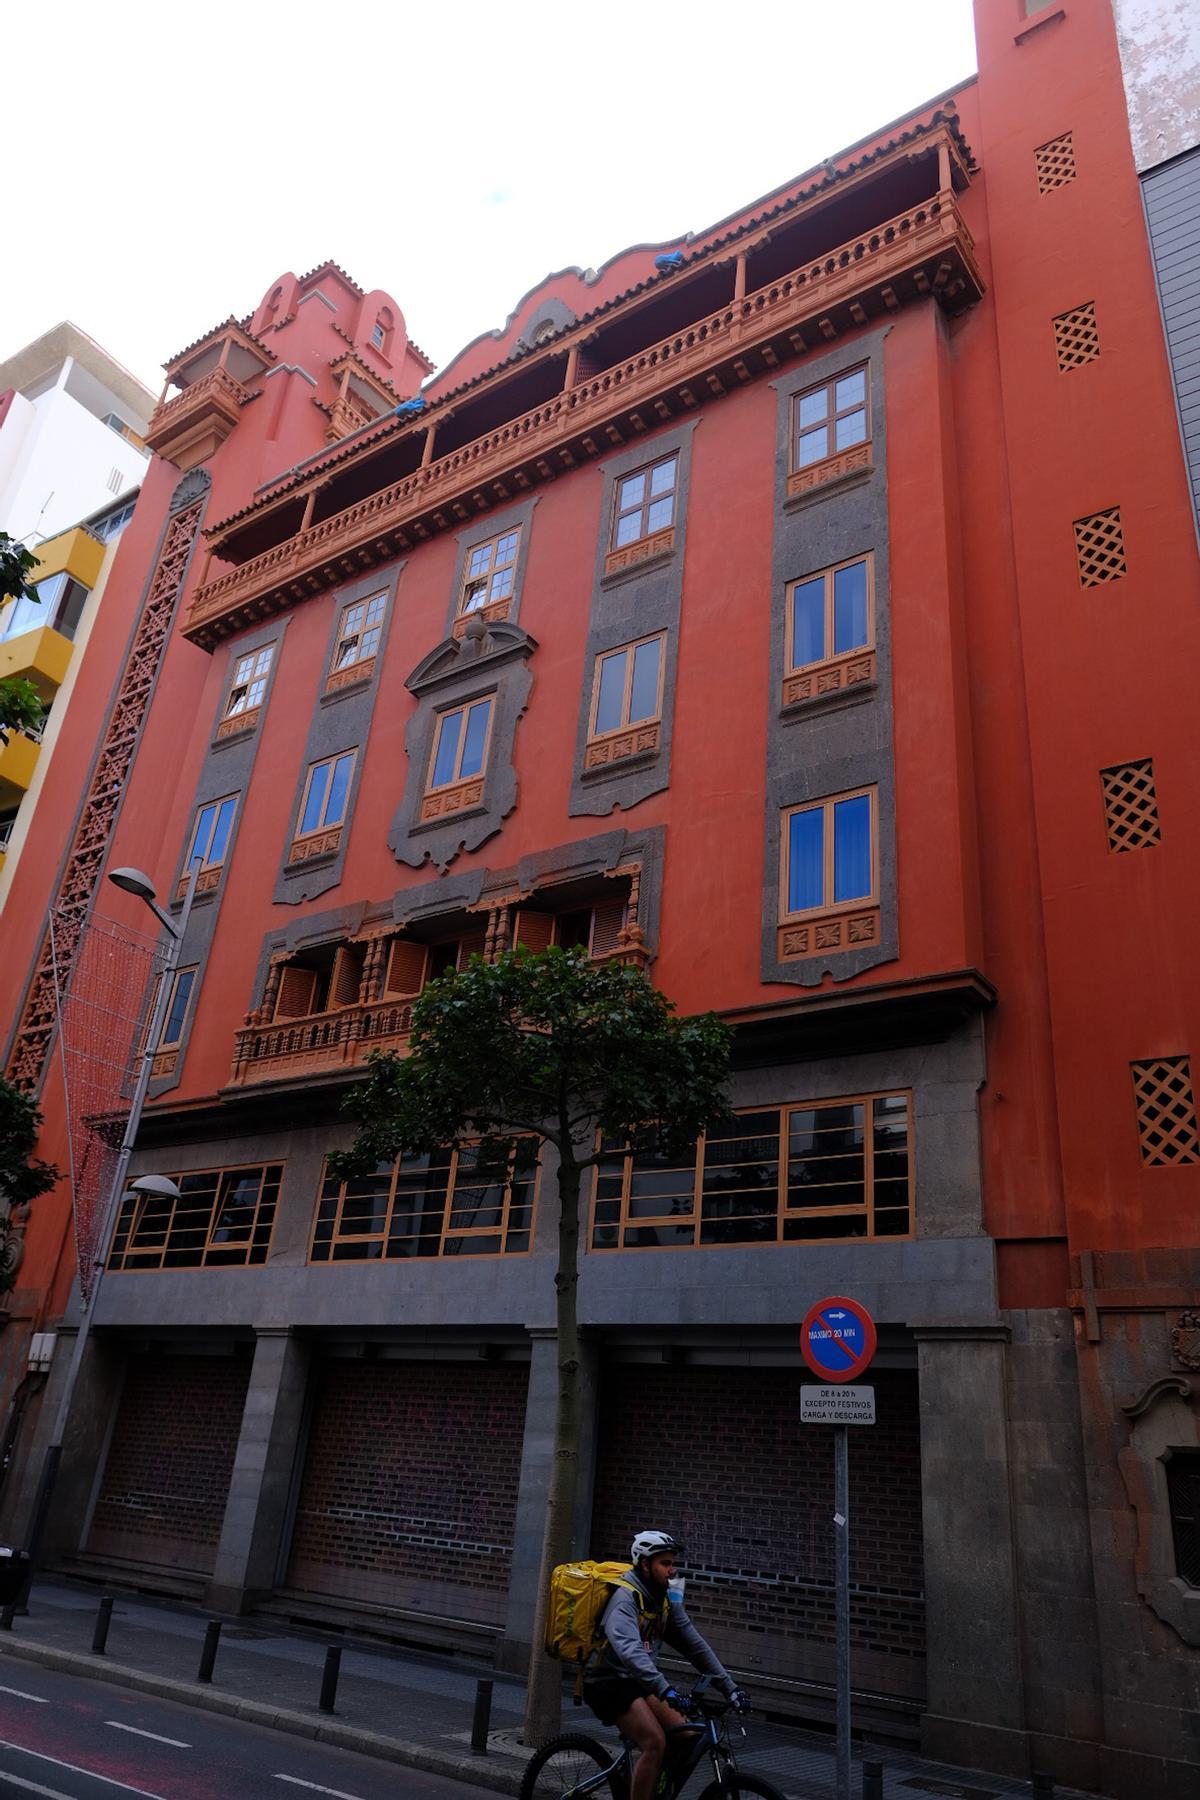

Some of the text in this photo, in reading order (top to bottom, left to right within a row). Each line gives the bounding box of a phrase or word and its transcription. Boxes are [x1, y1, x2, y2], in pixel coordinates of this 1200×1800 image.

[808, 1328, 856, 1340] MAXIMO 20 MIN
[841, 1390, 849, 1398] 20
[804, 1400, 872, 1408] EXCEPTO FESTIVOS
[802, 1411, 827, 1419] CARGA
[834, 1412, 873, 1420] DESCARGA
